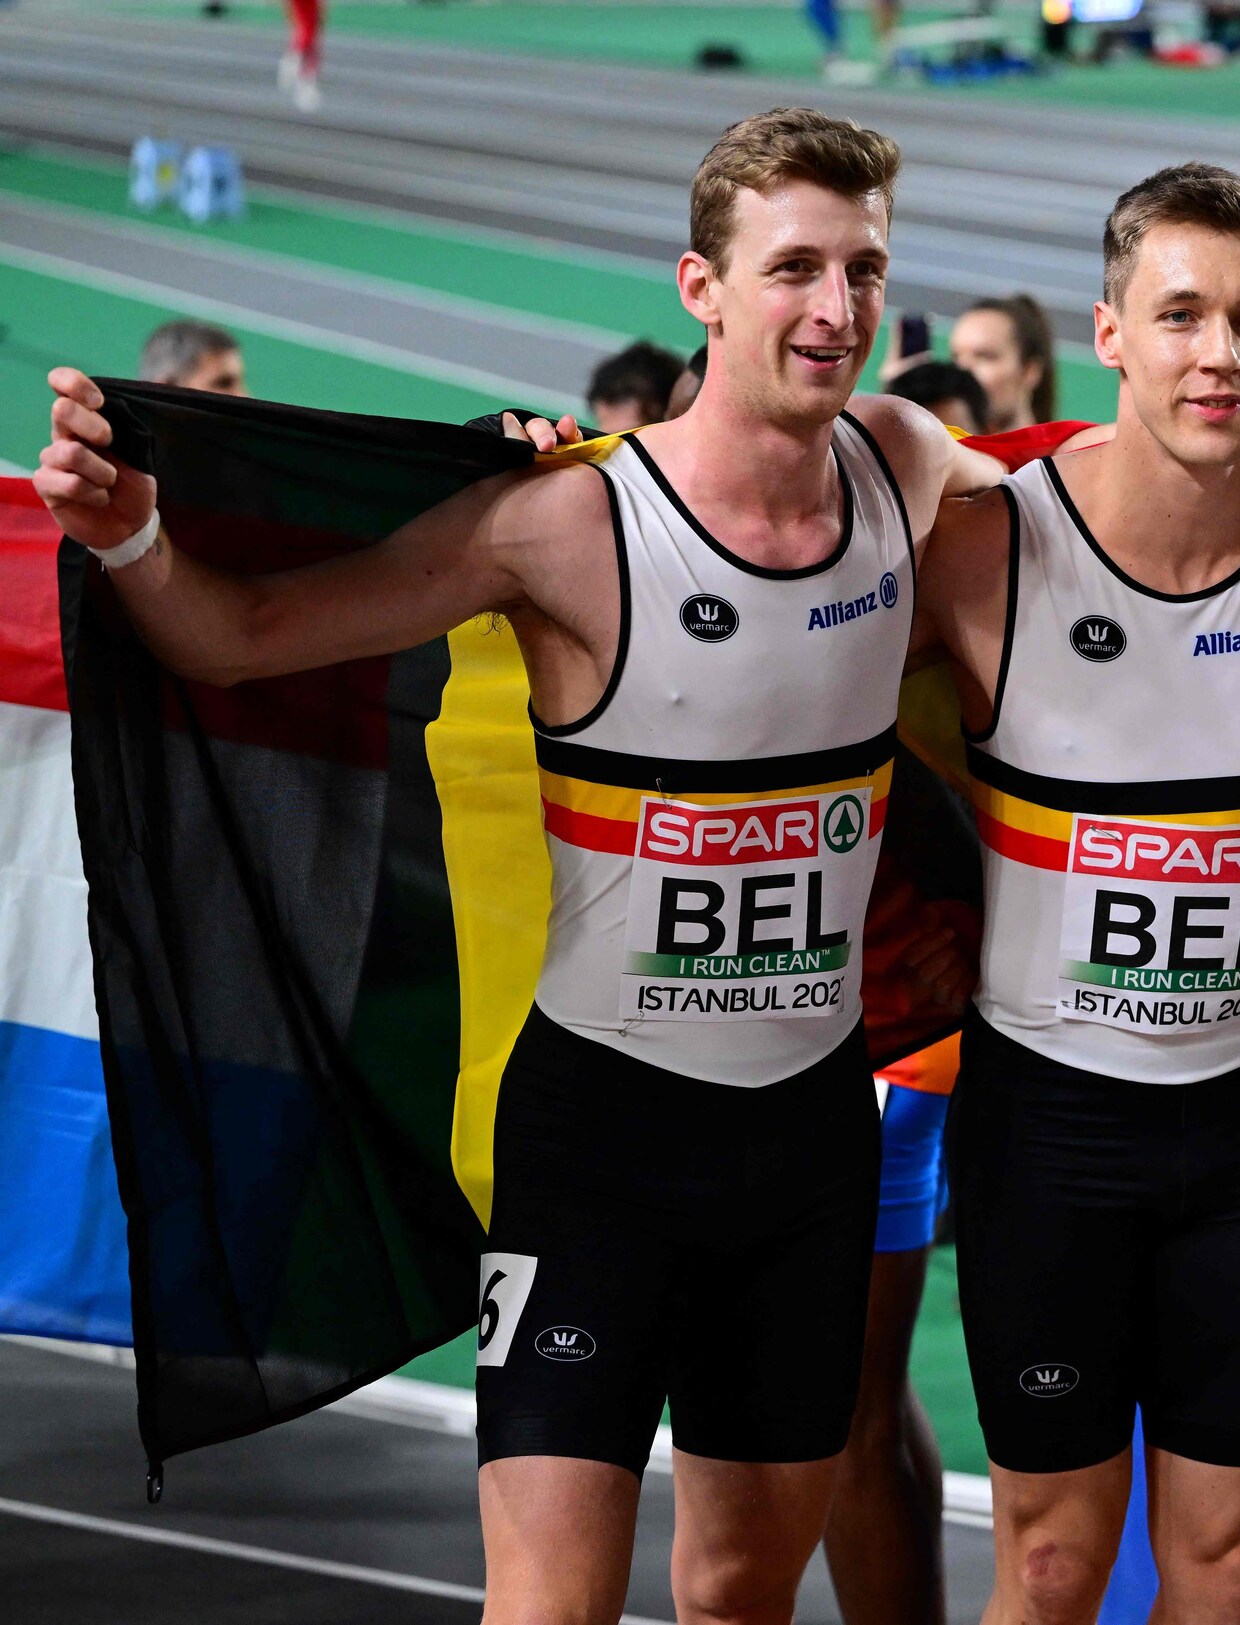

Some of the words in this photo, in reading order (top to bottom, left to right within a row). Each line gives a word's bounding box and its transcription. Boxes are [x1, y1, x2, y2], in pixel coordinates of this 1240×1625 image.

[807, 591, 878, 631] Allianz
[689, 622, 730, 632] vermarc
[1078, 642, 1117, 653] vermarc
[647, 810, 815, 858] SPAR
[655, 870, 849, 957] BEL
[679, 957, 686, 975] I
[692, 957, 743, 976] RUN
[1110, 967, 1118, 985] I
[1123, 969, 1172, 989] RUN
[637, 984, 786, 1013] ISTANBUL
[792, 975, 845, 1009] 202
[1073, 988, 1212, 1026] ISTANBUL
[478, 1269, 508, 1352] 6
[542, 1345, 586, 1356] vermarc
[1028, 1382, 1070, 1391] vermarc
